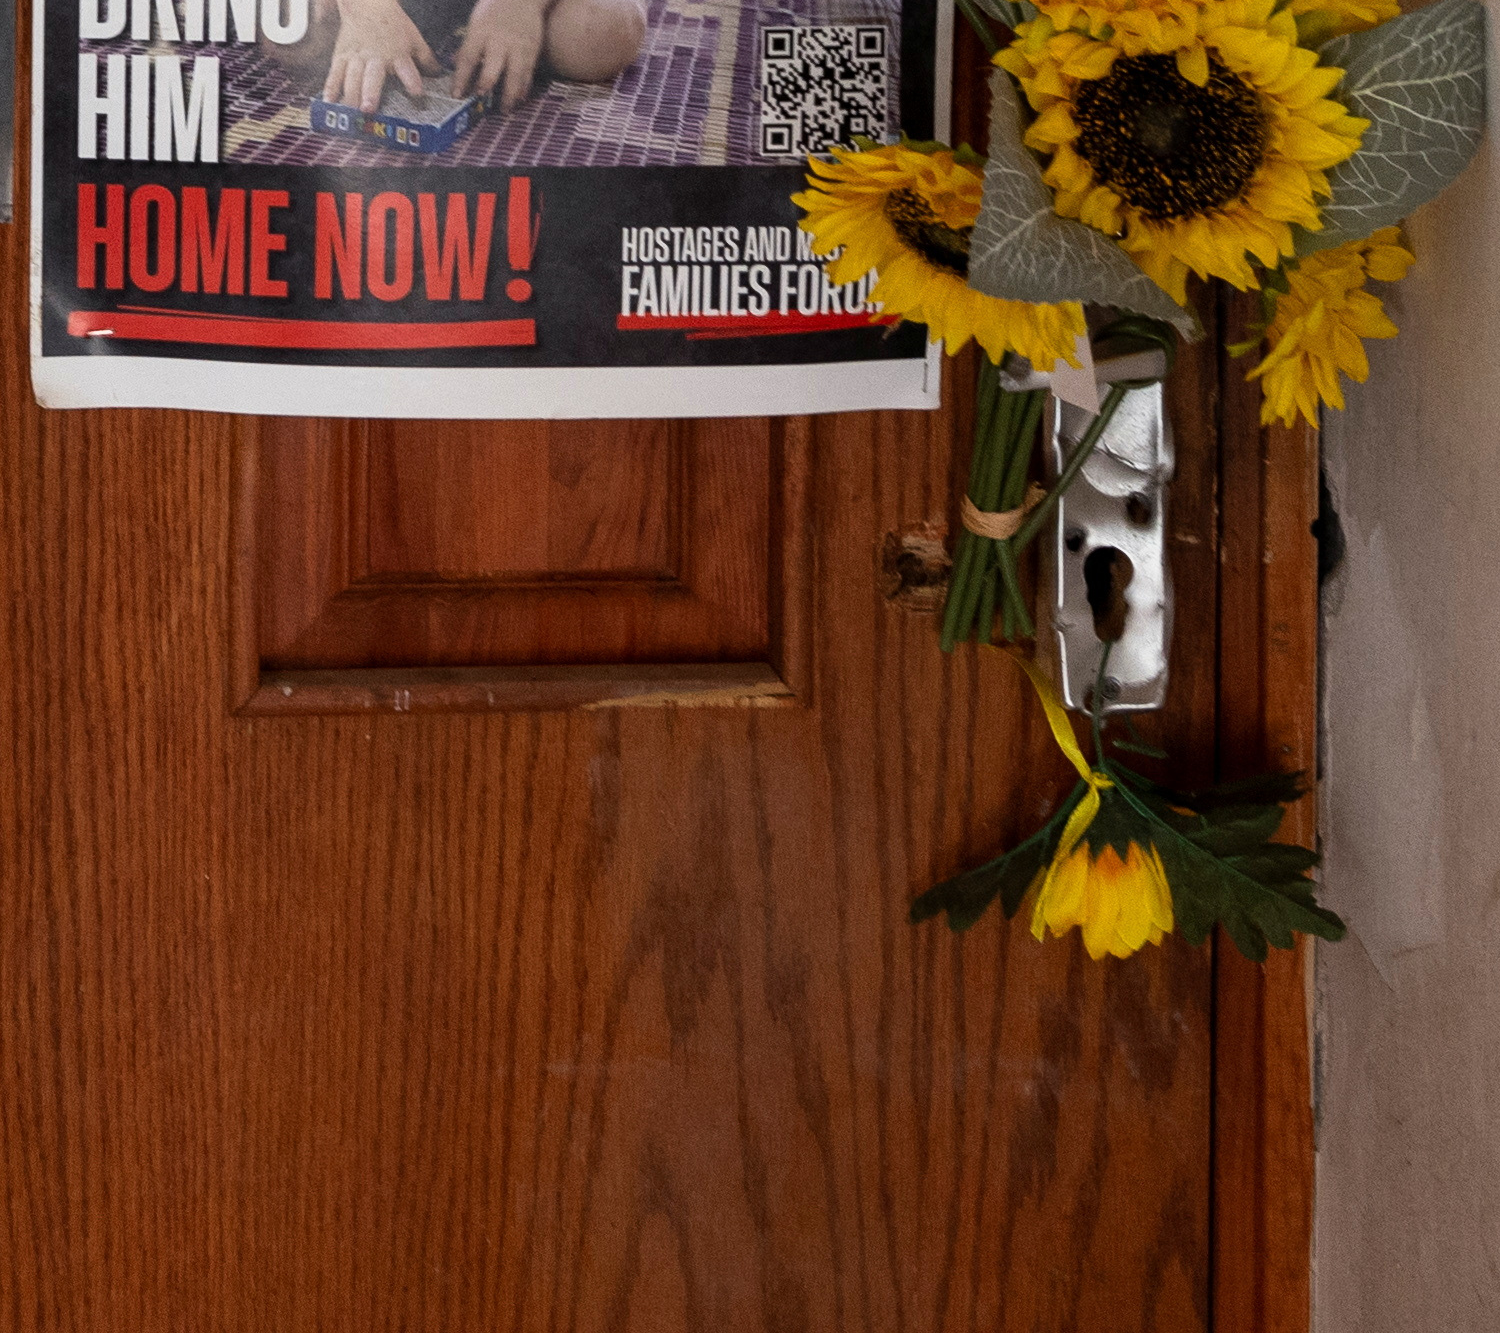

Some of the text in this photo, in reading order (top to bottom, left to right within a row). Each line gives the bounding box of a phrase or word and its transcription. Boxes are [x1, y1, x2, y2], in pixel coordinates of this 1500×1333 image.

[78, 53, 221, 163] HIM
[77, 176, 533, 303] HOME NOW!
[621, 226, 740, 263] HOSTAGES
[743, 226, 791, 263] AND
[620, 264, 771, 317] FAMILIES
